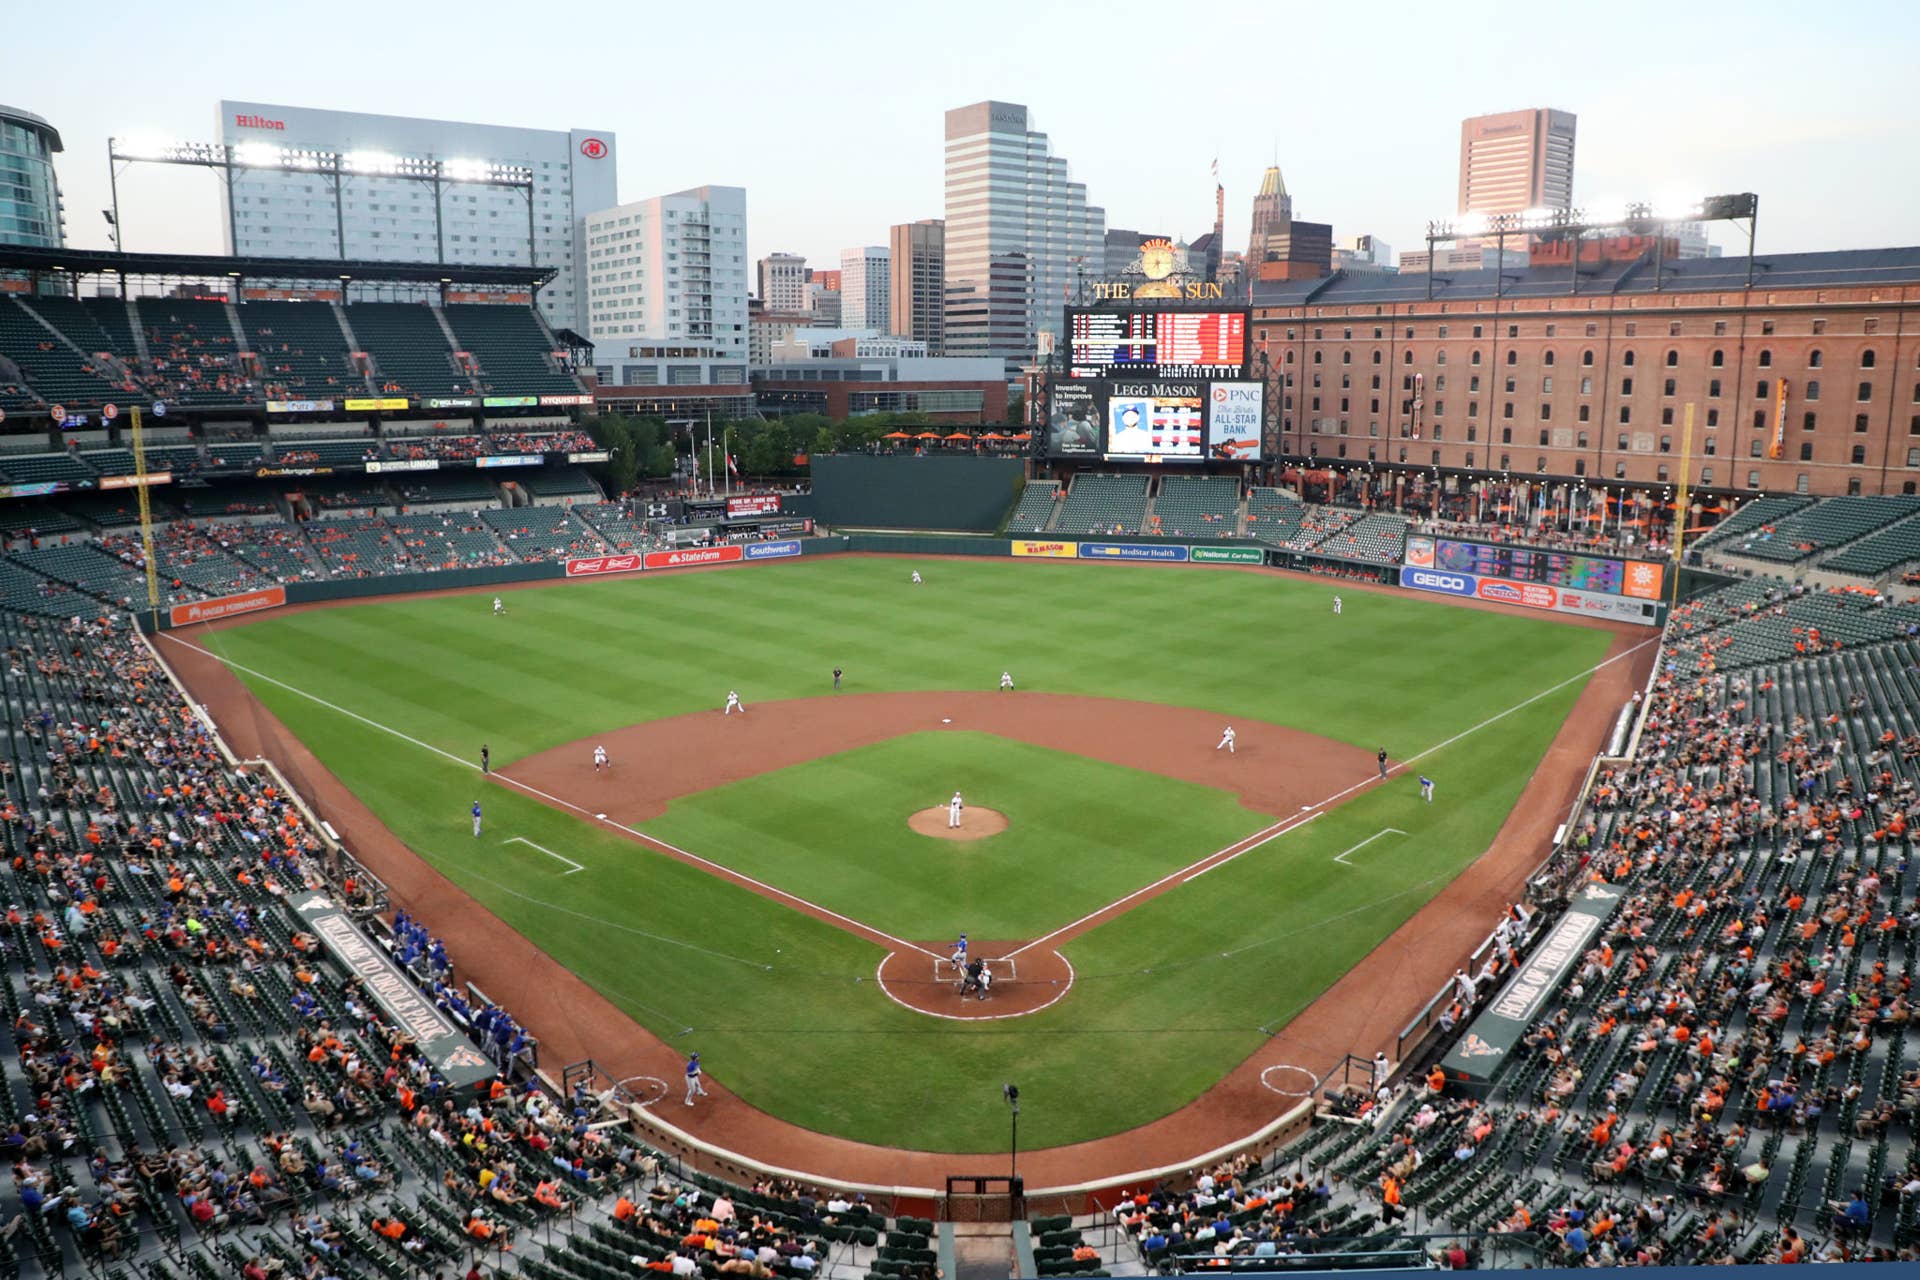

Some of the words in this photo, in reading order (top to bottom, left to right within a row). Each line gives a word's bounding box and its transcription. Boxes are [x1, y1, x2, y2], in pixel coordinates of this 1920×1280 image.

[236, 114, 285, 130] Hilton
[1139, 238, 1176, 254] ORIOLES
[1092, 283, 1130, 299] THE
[1186, 282, 1223, 299] SUN
[1055, 384, 1087, 392] Investing
[1113, 383, 1148, 396] LEGG
[1151, 383, 1198, 397] MASON
[1230, 390, 1260, 401] PNC
[1065, 392, 1093, 400] Improve
[1215, 414, 1257, 424] ALL-STAR
[1223, 425, 1247, 434] BANK
[410, 460, 439, 470] UNION
[751, 545, 790, 555] Southwest
[1121, 548, 1149, 556] MedStar
[1203, 551, 1230, 559] National
[1413, 572, 1465, 591] GEICO
[1483, 586, 1521, 600] HORIZON
[320, 915, 370, 961] WELCOME
[356, 957, 385, 975] TO
[1532, 948, 1567, 970] THE
[1522, 967, 1551, 985] OF
[370, 972, 419, 1013] ORIOLE
[1495, 982, 1540, 1018] HOME
[407, 1007, 447, 1041] PARK
